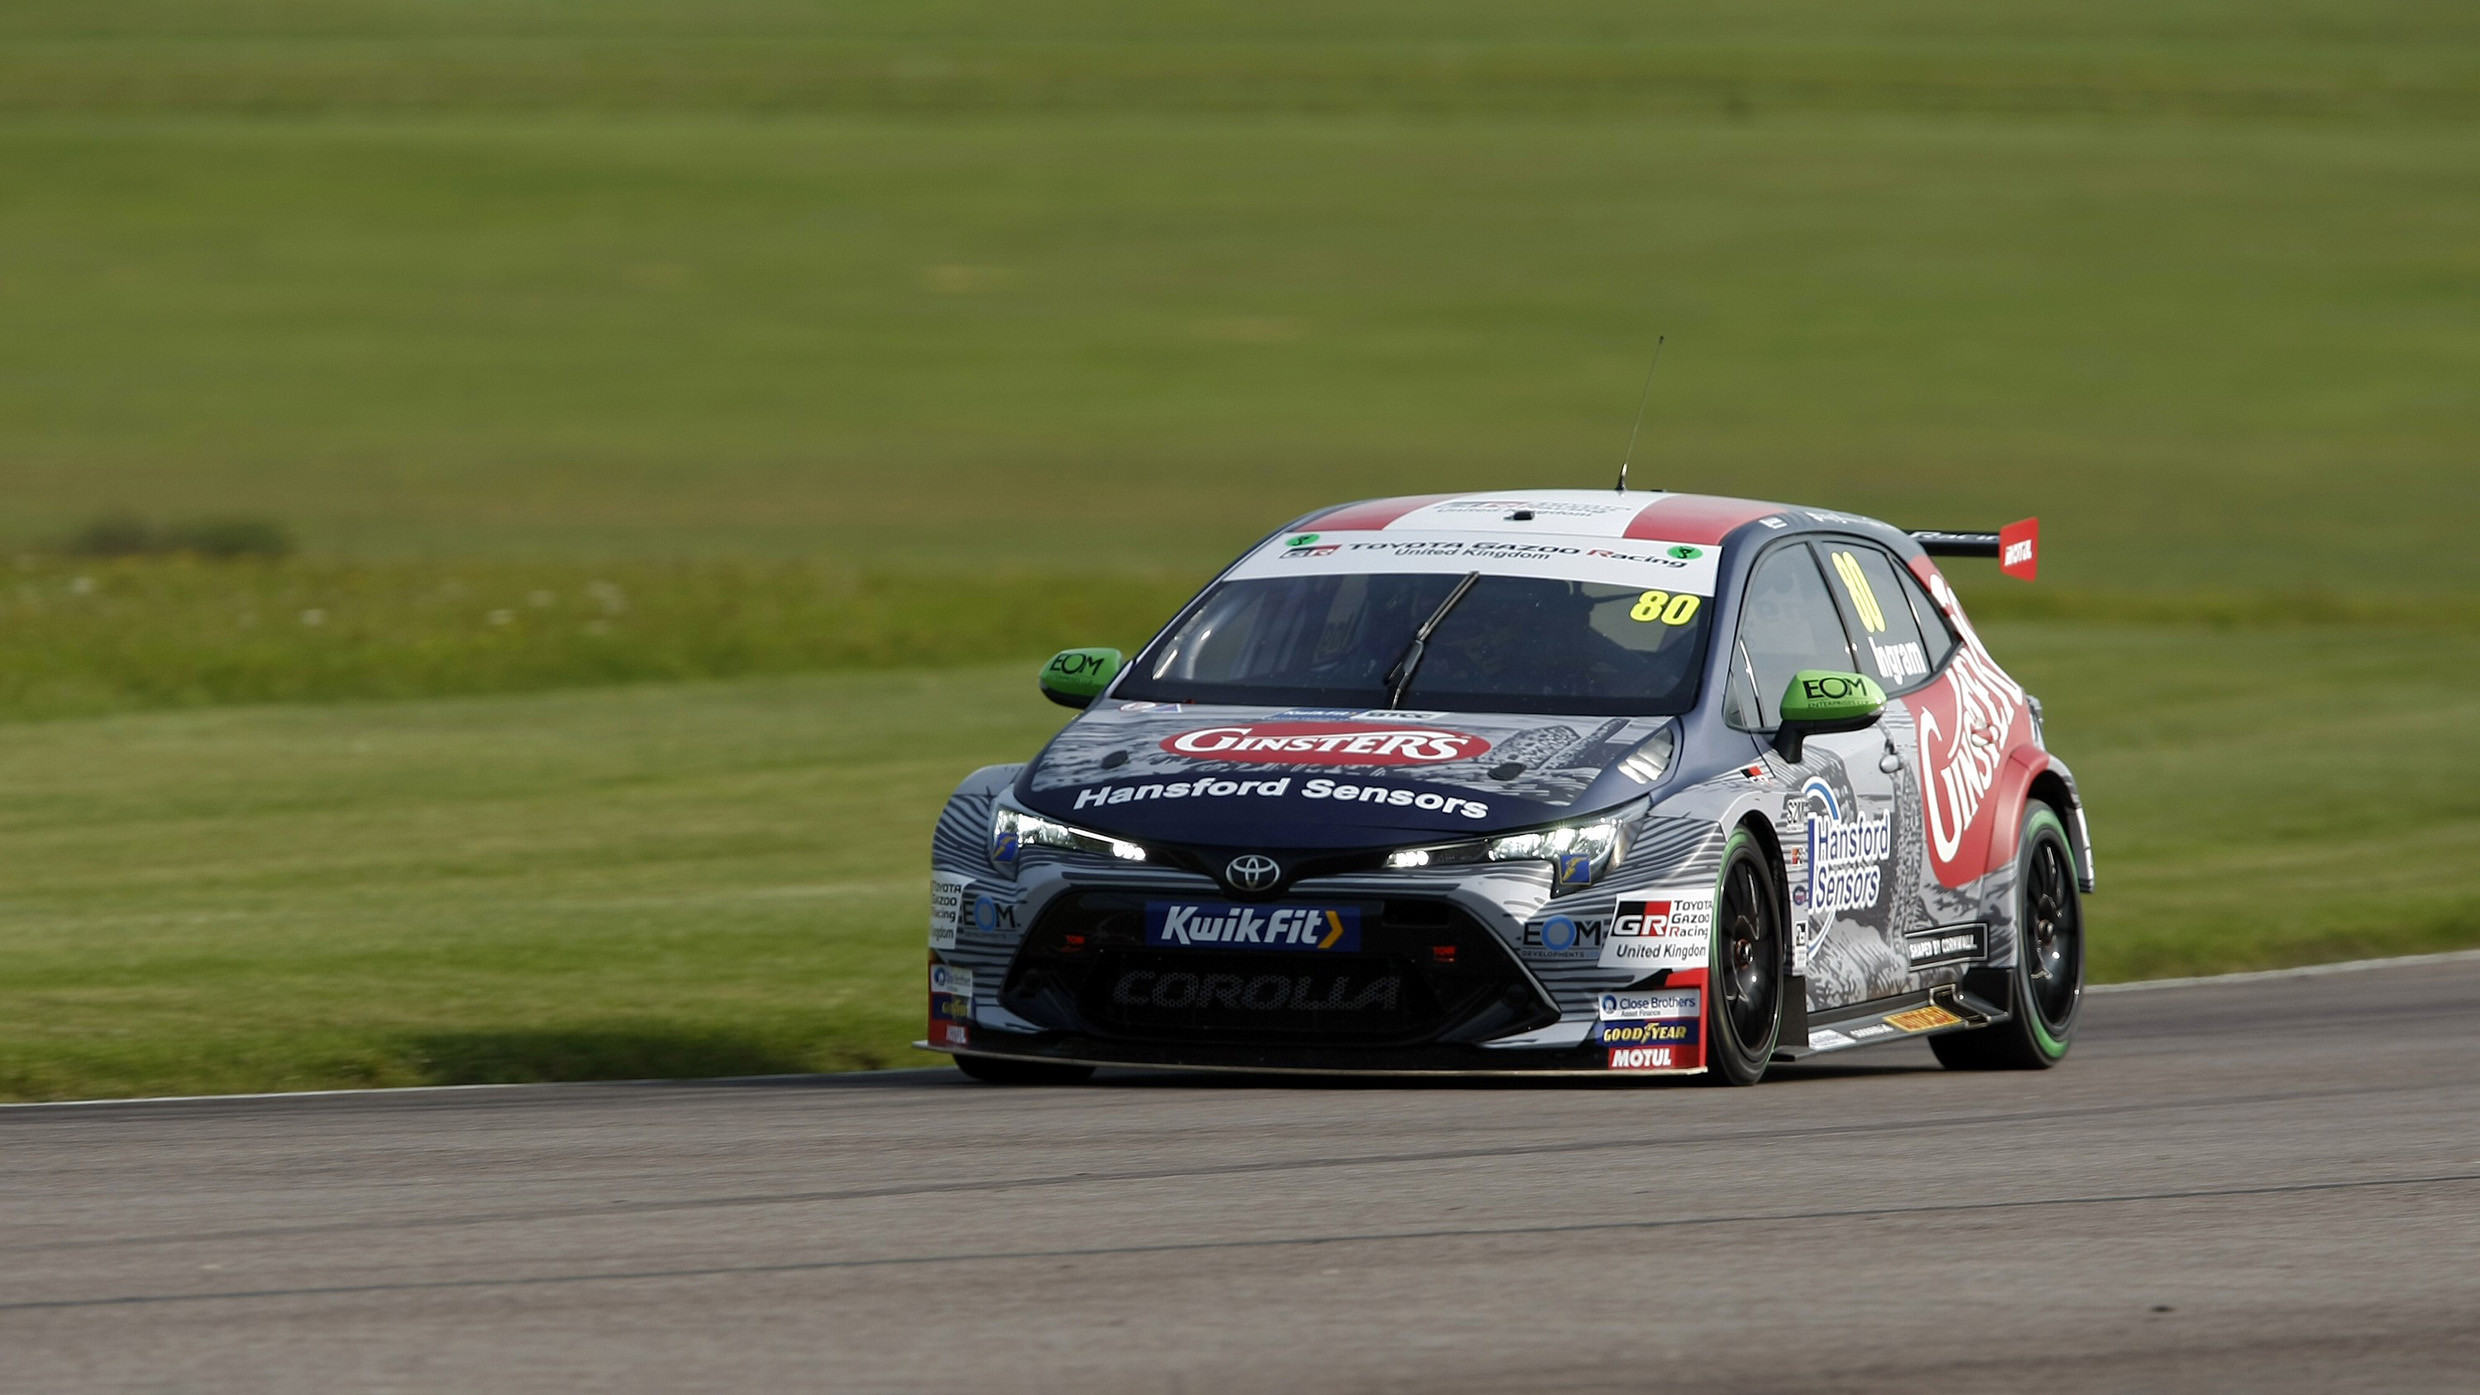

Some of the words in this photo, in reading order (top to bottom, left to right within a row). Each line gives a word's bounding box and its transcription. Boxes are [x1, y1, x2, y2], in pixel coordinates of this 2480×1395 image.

[1349, 541, 1464, 550] TOYOTA
[1472, 542, 1581, 555] GAZOO
[1586, 549, 1688, 569] Racing
[1394, 548, 1459, 556] United
[1461, 548, 1551, 560] Kingdom
[1829, 550, 1887, 634] 80
[1629, 589, 1702, 626] 80
[1049, 653, 1105, 676] EOM
[1867, 637, 1927, 685] Ingram
[1802, 677, 1868, 700] EOM
[1174, 727, 1469, 760] GINSTERS
[1073, 777, 1291, 810] Hansford
[1301, 778, 1489, 820] Sensors
[1818, 812, 1890, 862] Hansford
[1816, 866, 1880, 907] Sensors
[961, 894, 1016, 932] EOM
[1612, 914, 1668, 936] GR
[1523, 914, 1602, 951] EOM
[1616, 944, 1661, 958] United
[1620, 998, 1649, 1010] Close
[1651, 996, 1696, 1009] Brothers
[1603, 1023, 1688, 1044] GOODYEAR
[1611, 1048, 1672, 1068] MOTUL
